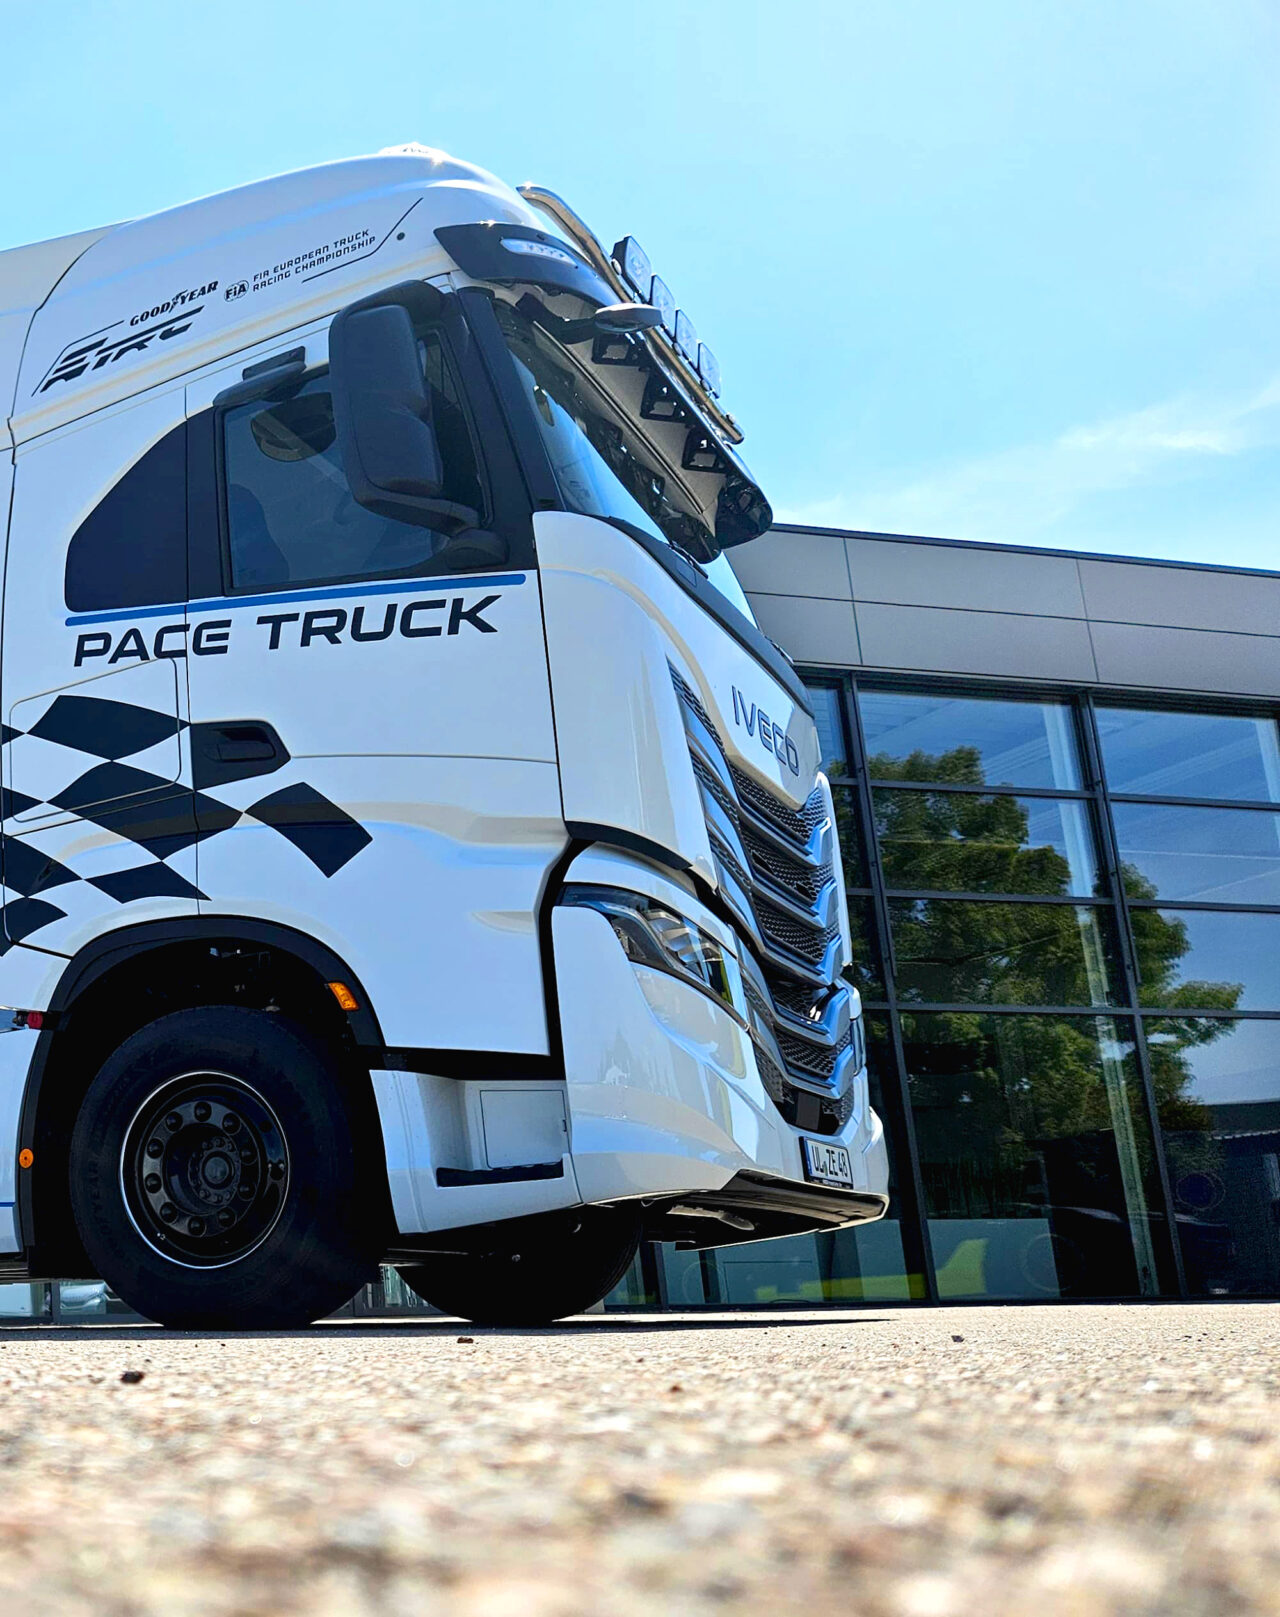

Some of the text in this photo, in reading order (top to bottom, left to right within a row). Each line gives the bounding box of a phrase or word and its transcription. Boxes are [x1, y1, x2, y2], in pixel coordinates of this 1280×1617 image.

[252, 236, 376, 292] RACING CHAMPIONSHIP
[253, 229, 369, 282] FIA EUROPEAN TRUCK
[129, 280, 219, 327] GOODYEAR
[73, 594, 502, 667] PACE TRUCK
[731, 685, 800, 777] IVECO
[811, 1145, 824, 1173] UL
[826, 1149, 838, 1176] ZE
